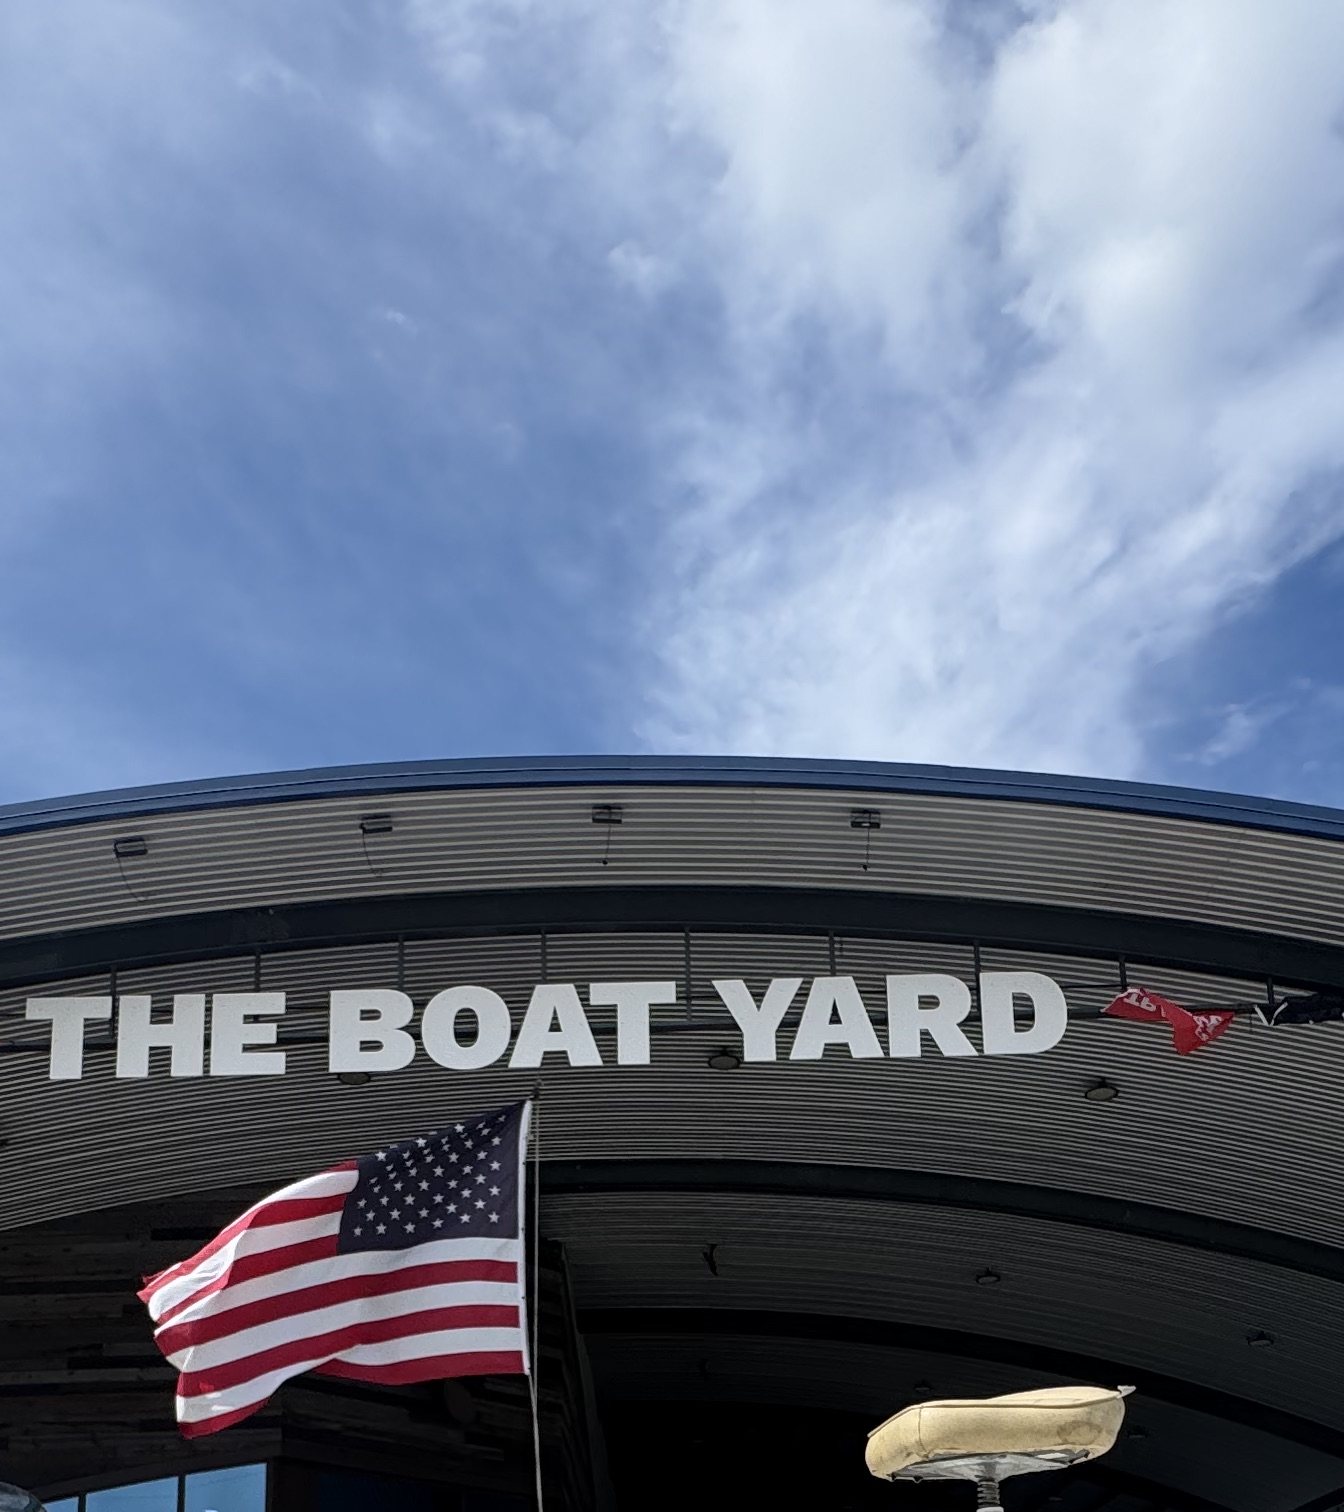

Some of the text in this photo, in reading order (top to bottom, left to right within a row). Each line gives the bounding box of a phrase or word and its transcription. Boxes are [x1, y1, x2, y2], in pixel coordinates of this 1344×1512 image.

[25, 972, 1068, 1080] THE BOAT YARD
